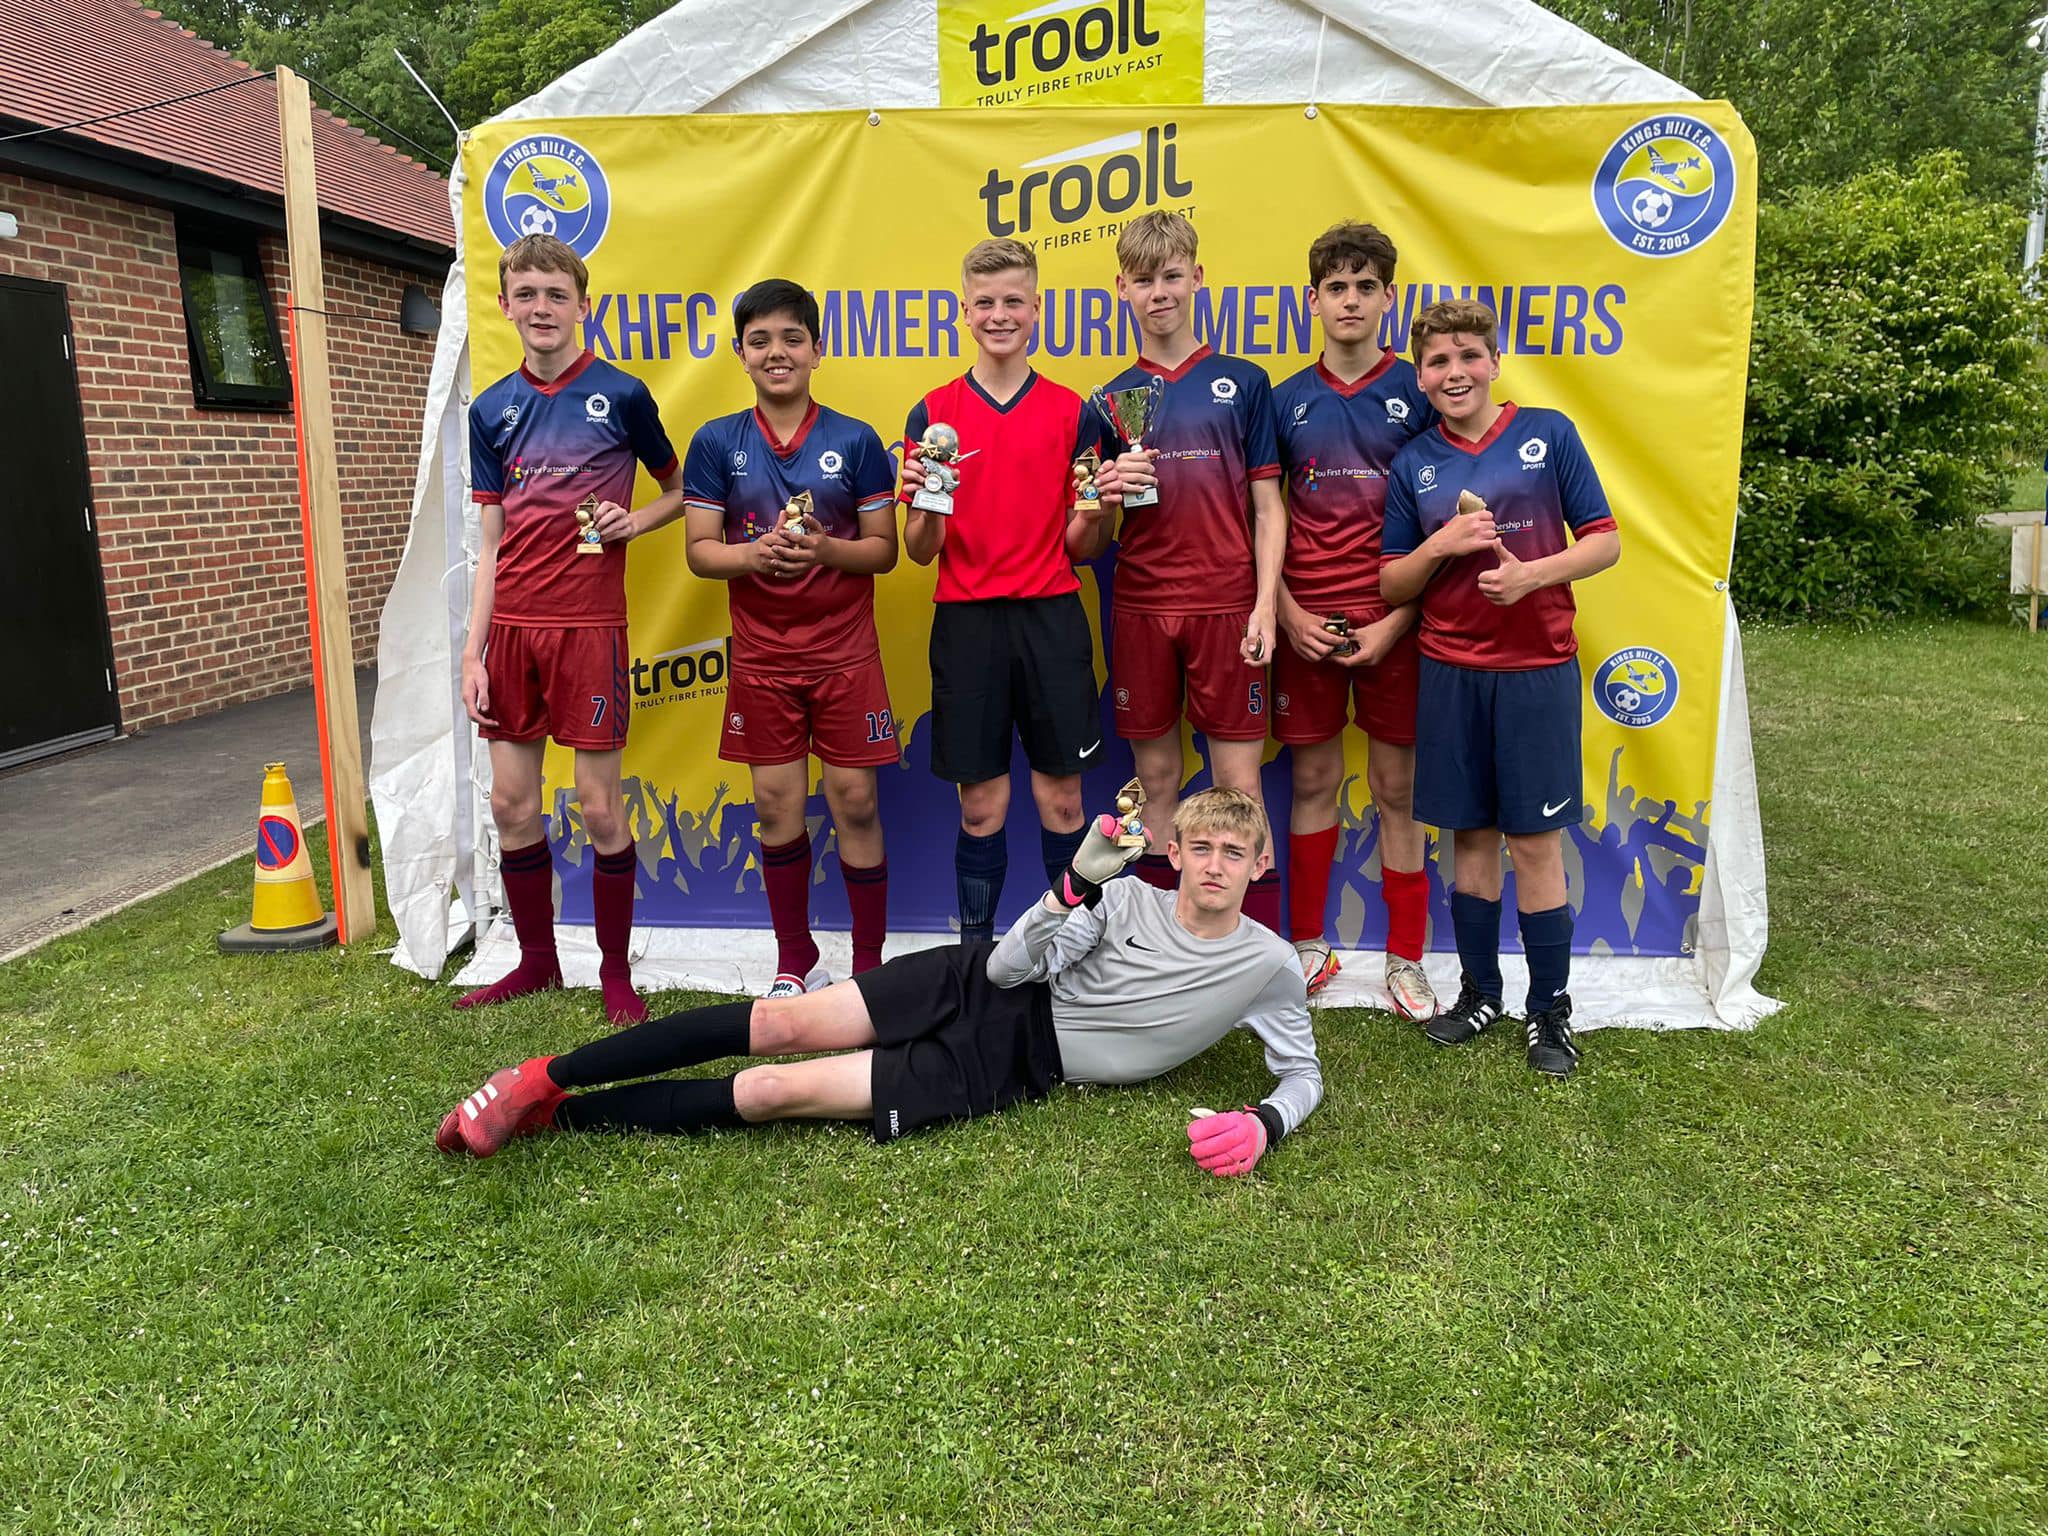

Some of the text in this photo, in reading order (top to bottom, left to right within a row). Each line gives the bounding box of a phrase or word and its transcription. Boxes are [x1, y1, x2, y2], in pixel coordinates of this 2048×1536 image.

[976, 54, 1163, 107] TRULY FIBRE TRULY FAST
[1620, 121, 1712, 153] KINGS HILL F.C.
[503, 140, 586, 170] KINGS HILL F.C.
[979, 122, 1193, 237] trooli
[1044, 228, 1092, 251] FIBRE
[1631, 232, 1690, 251] EST. 2003
[583, 292, 717, 361] KHFC
[732, 288, 960, 358] MMER
[1172, 449, 1209, 458] Partnership
[1522, 462, 1546, 470] SPORTS
[542, 464, 579, 474] Partnership
[1327, 468, 1341, 476] First
[753, 525, 767, 533] You
[1522, 519, 1534, 528] Ltd
[630, 635, 732, 696] trool
[1609, 651, 1634, 668] KINGS
[1636, 650, 1652, 660] HILL
[635, 697, 666, 710] TRULY
[669, 691, 697, 703] FIBRE
[1247, 681, 1263, 715] 5
[591, 696, 607, 726] 7
[866, 709, 894, 742] 12
[889, 1109, 900, 1137] mac
